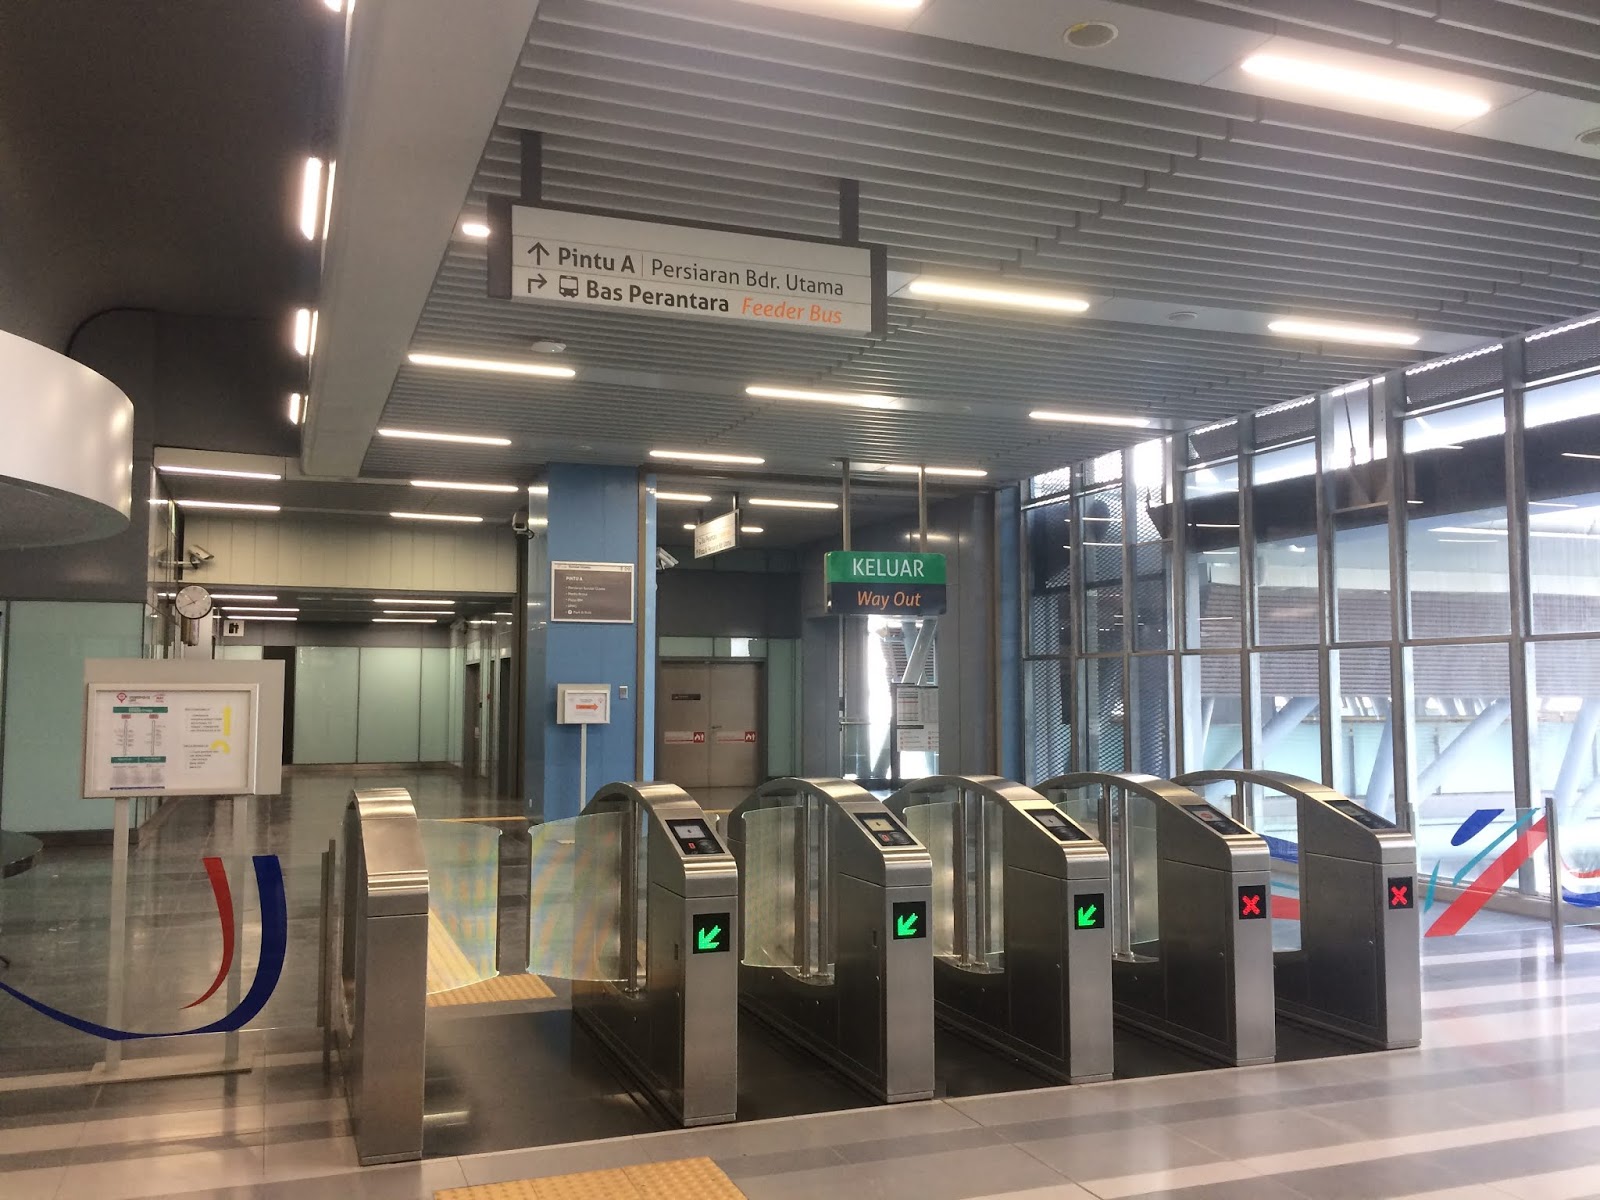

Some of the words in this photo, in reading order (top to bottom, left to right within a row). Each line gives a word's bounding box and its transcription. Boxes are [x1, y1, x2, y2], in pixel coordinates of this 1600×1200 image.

[558, 246, 615, 271] Pintu
[620, 254, 636, 274] A
[651, 258, 740, 286] Persiaran
[746, 269, 780, 290] Bdr.
[786, 273, 844, 296] Utama
[586, 280, 623, 301] Bas
[629, 284, 730, 312] Perantara
[741, 296, 805, 321] Feeder
[809, 304, 842, 324] Bus
[852, 557, 925, 578] KELUAR
[857, 590, 889, 610] Way
[893, 591, 922, 607] Out
